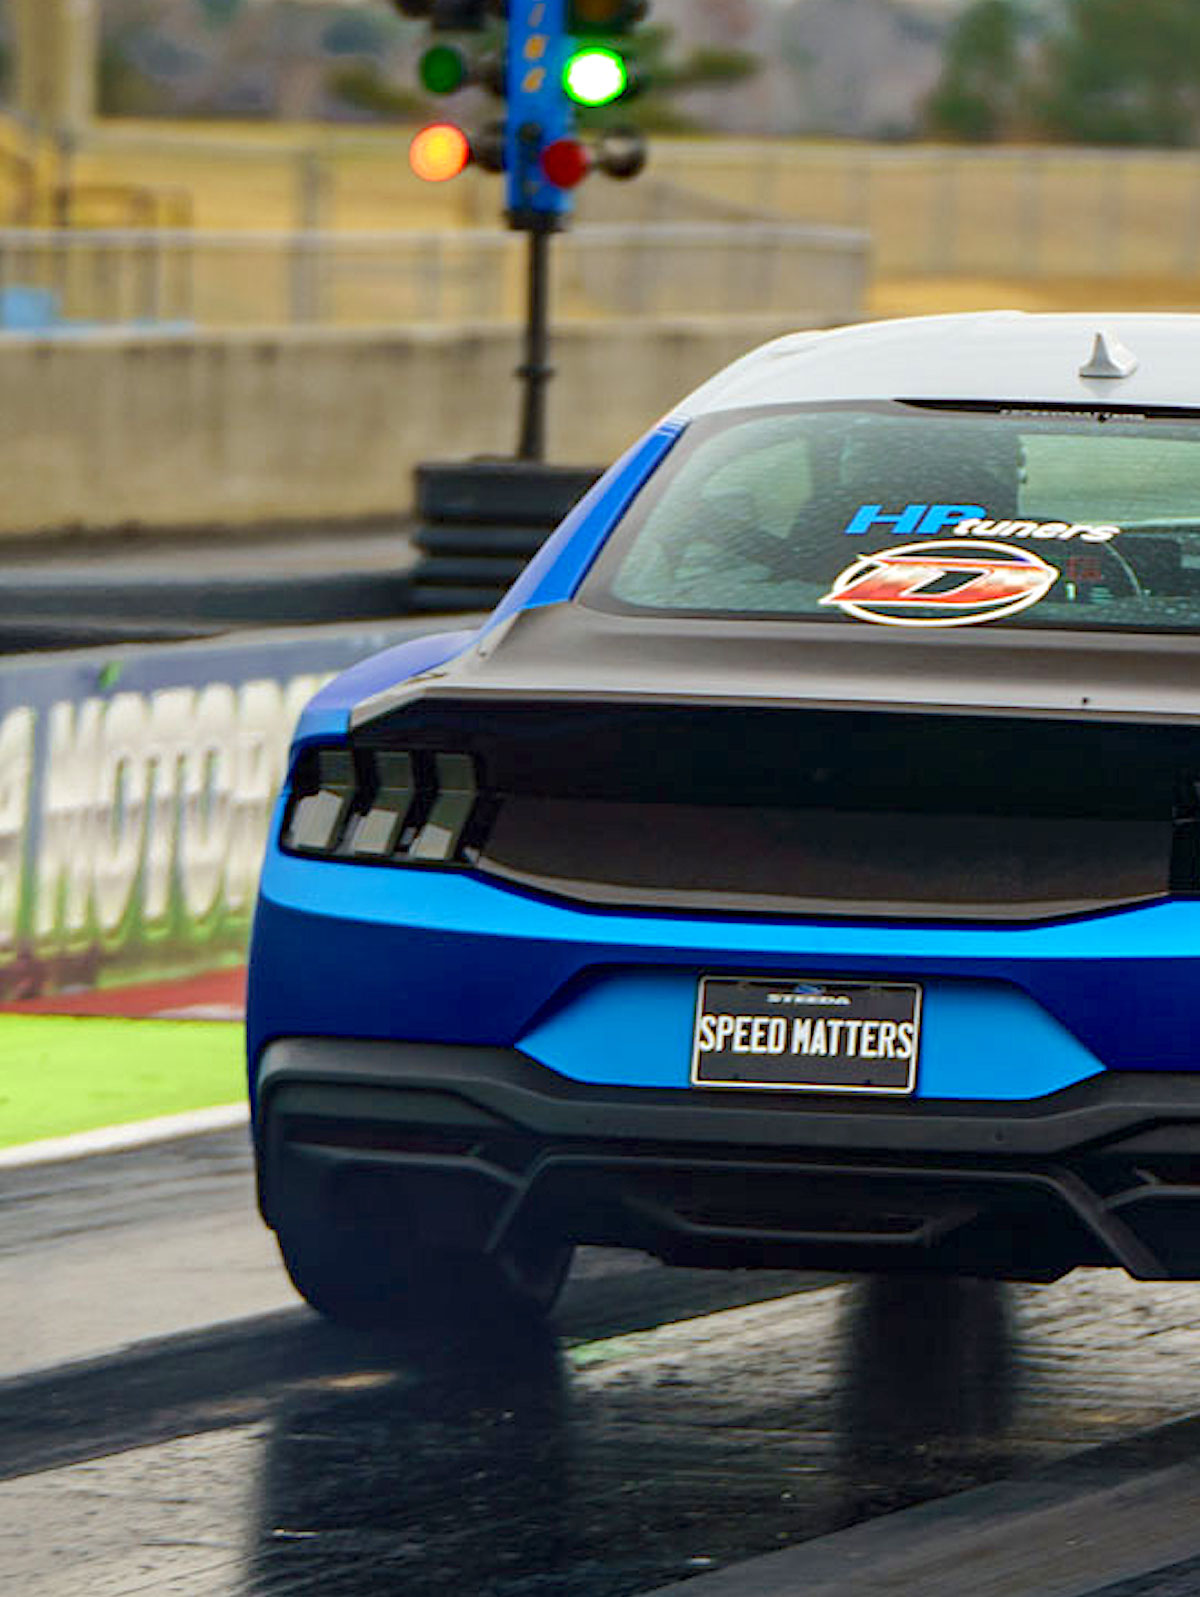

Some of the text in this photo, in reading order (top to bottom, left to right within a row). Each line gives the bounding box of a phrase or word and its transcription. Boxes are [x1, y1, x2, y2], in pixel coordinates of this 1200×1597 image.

[954, 517, 1120, 543] tuners
[700, 1015, 913, 1058] SPEED MATTERS
